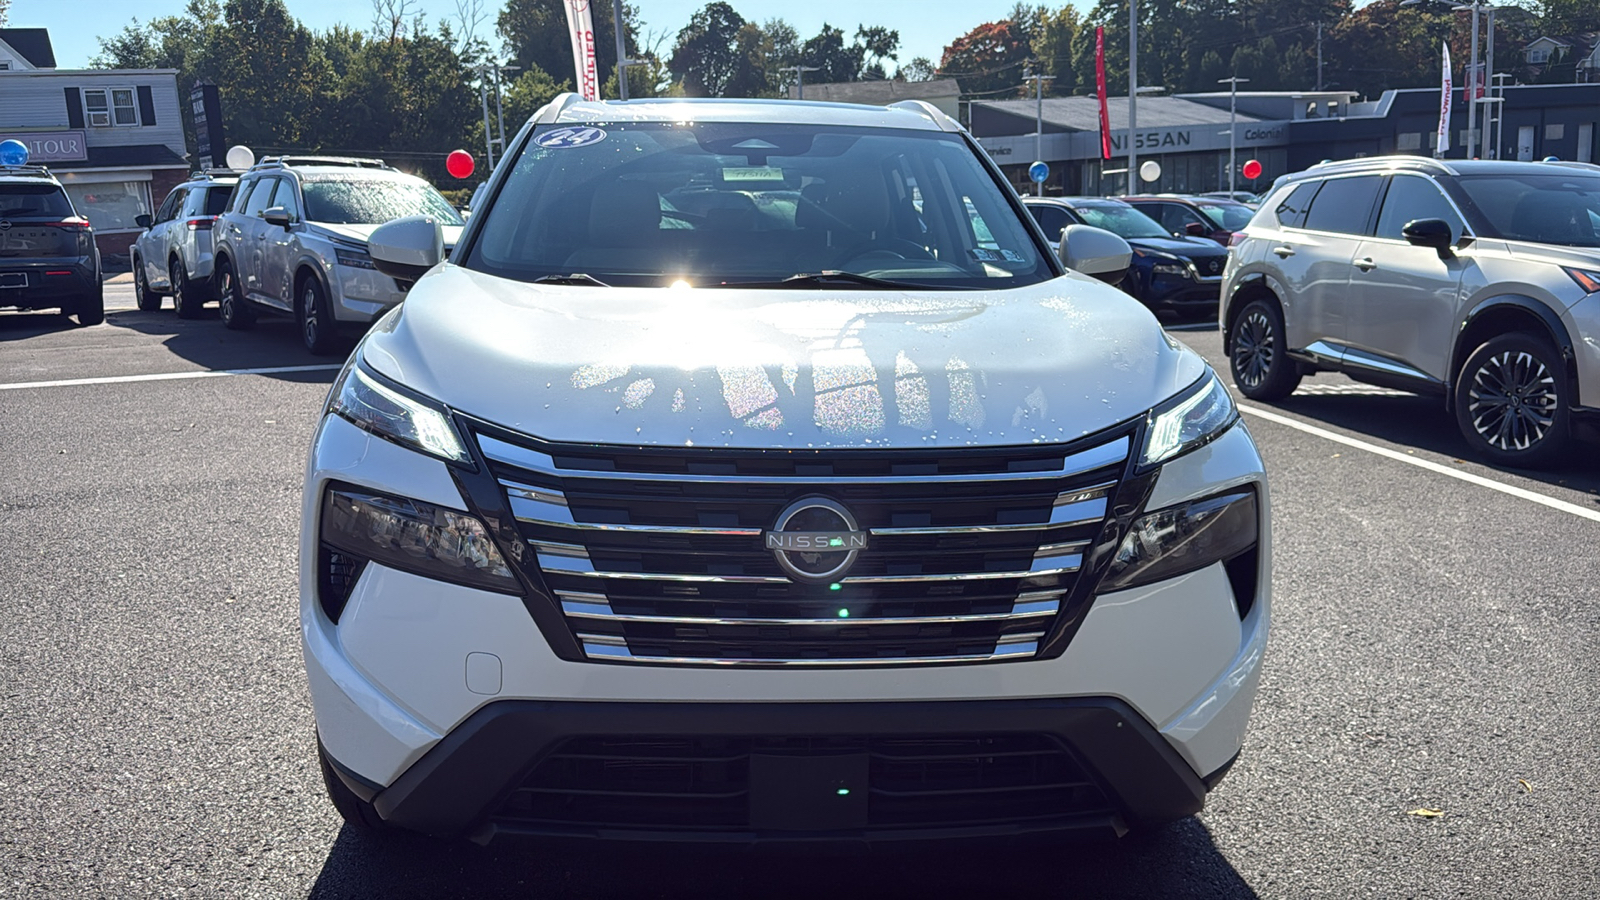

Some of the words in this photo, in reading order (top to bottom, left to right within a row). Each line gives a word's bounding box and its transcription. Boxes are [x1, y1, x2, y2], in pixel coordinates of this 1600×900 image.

[541, 128, 598, 146] 24
[1245, 127, 1284, 140] Colonial
[985, 146, 1012, 156] ervice
[768, 534, 865, 548] NISSAN
